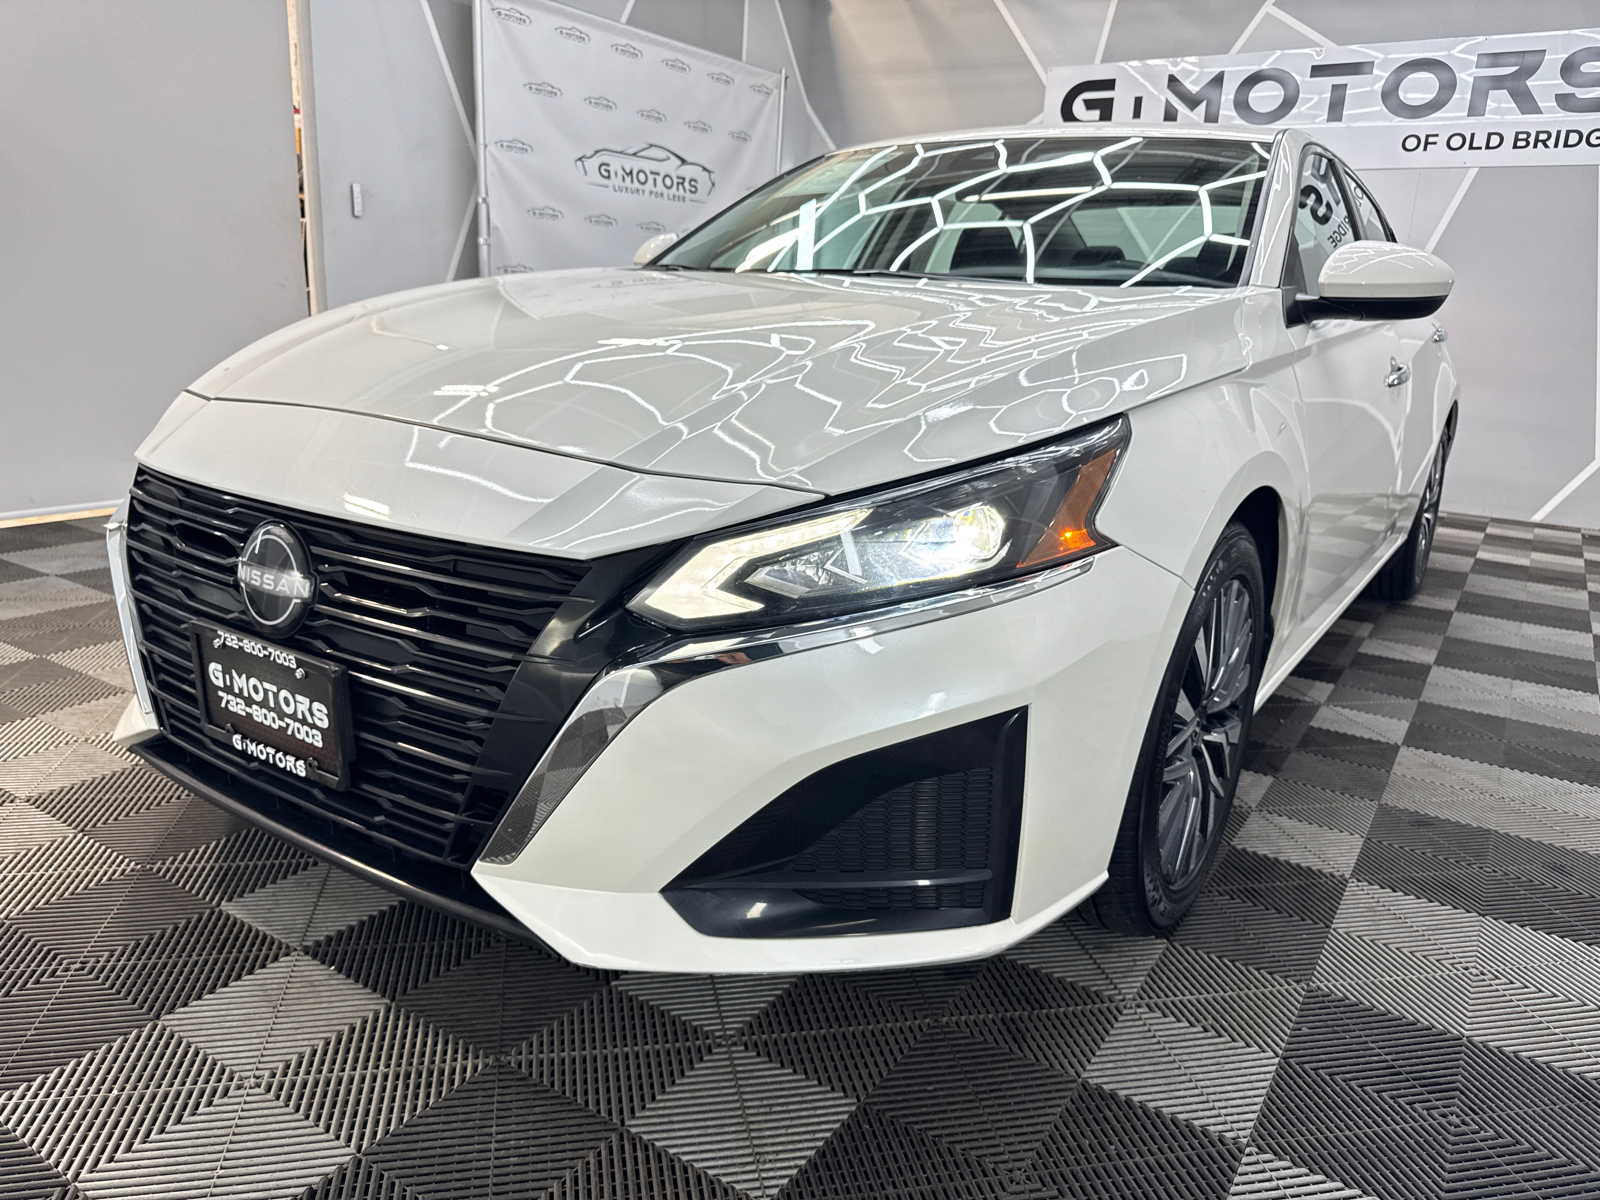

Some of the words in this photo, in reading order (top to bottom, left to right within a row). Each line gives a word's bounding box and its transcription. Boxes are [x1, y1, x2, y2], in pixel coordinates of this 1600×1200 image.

[1401, 133, 1440, 153] OF
[1445, 131, 1505, 152] OLD
[612, 184, 646, 197] LUXURY
[649, 190, 665, 200] FOR
[667, 193, 687, 204] LESS
[621, 165, 699, 195] MOTORS
[237, 560, 310, 598] NISSAN
[217, 631, 297, 669] 732-800-7003
[217, 690, 324, 749] 732-800-7003
